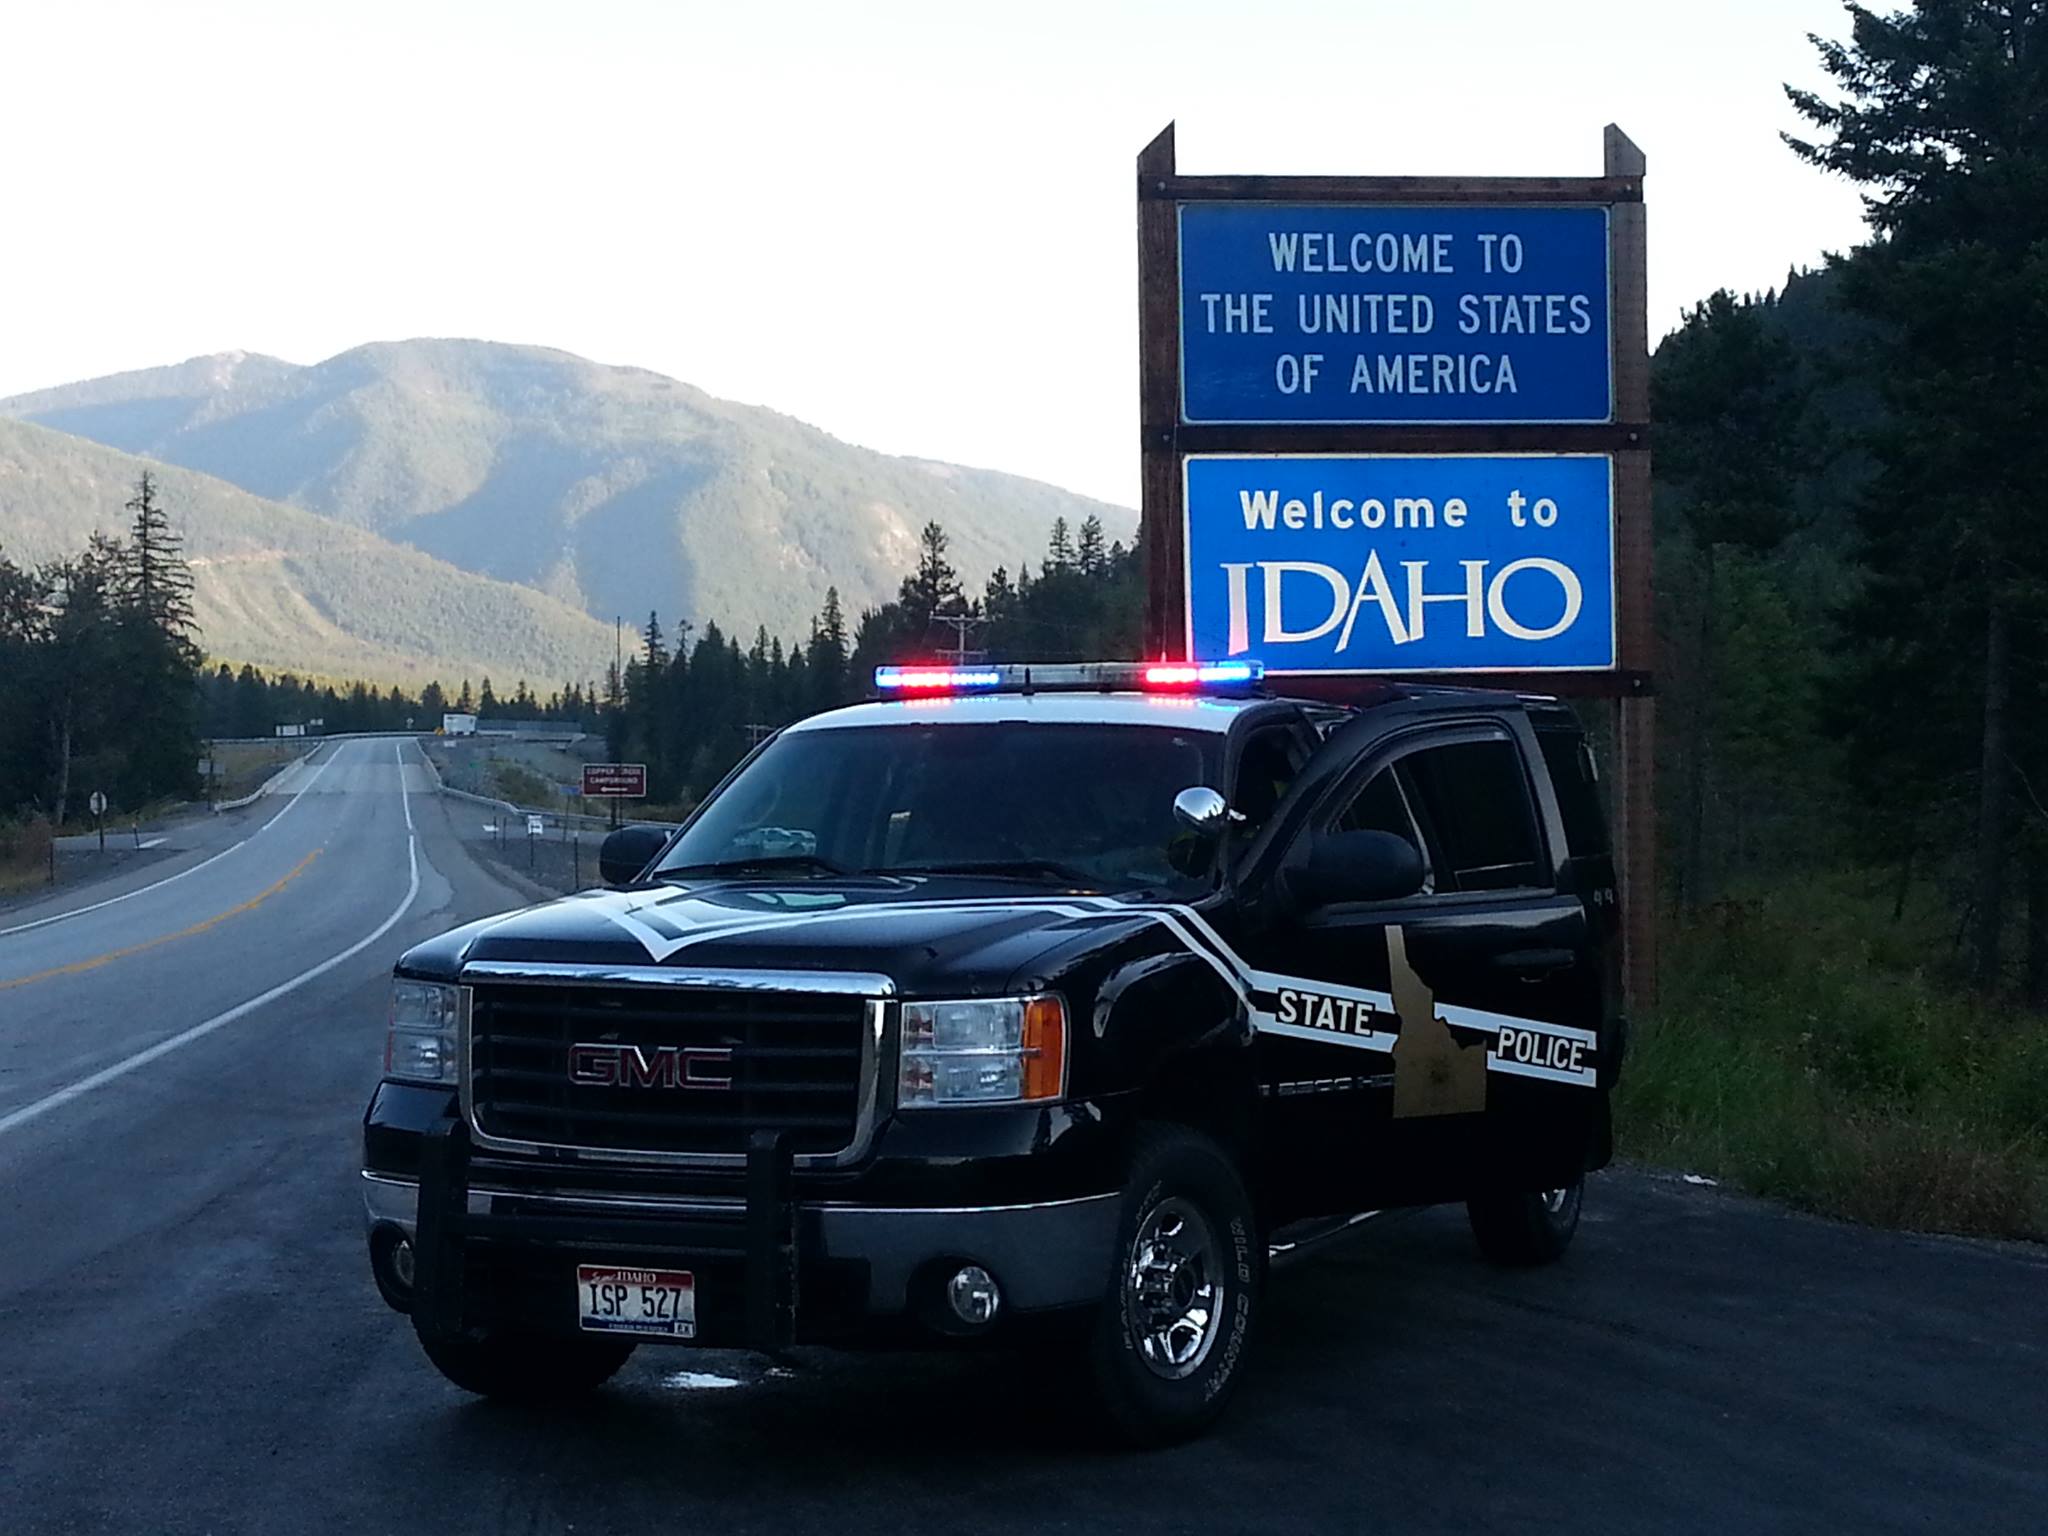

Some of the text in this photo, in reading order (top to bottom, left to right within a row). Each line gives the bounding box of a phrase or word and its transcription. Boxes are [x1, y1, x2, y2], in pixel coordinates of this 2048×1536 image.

[1268, 232, 1524, 274] WELCOME TO
[1201, 293, 1593, 335] THE UNITED STATES
[1275, 354, 1519, 395] OF AMERICA
[1239, 488, 1559, 531] Welcome to
[1219, 548, 1584, 657] IDAHO
[1277, 990, 1374, 1036] STATE
[567, 1042, 733, 1091] GMC
[1496, 1027, 1588, 1073] POLICE
[617, 1271, 657, 1284] IDAHO
[589, 1283, 682, 1319] ISP 527
